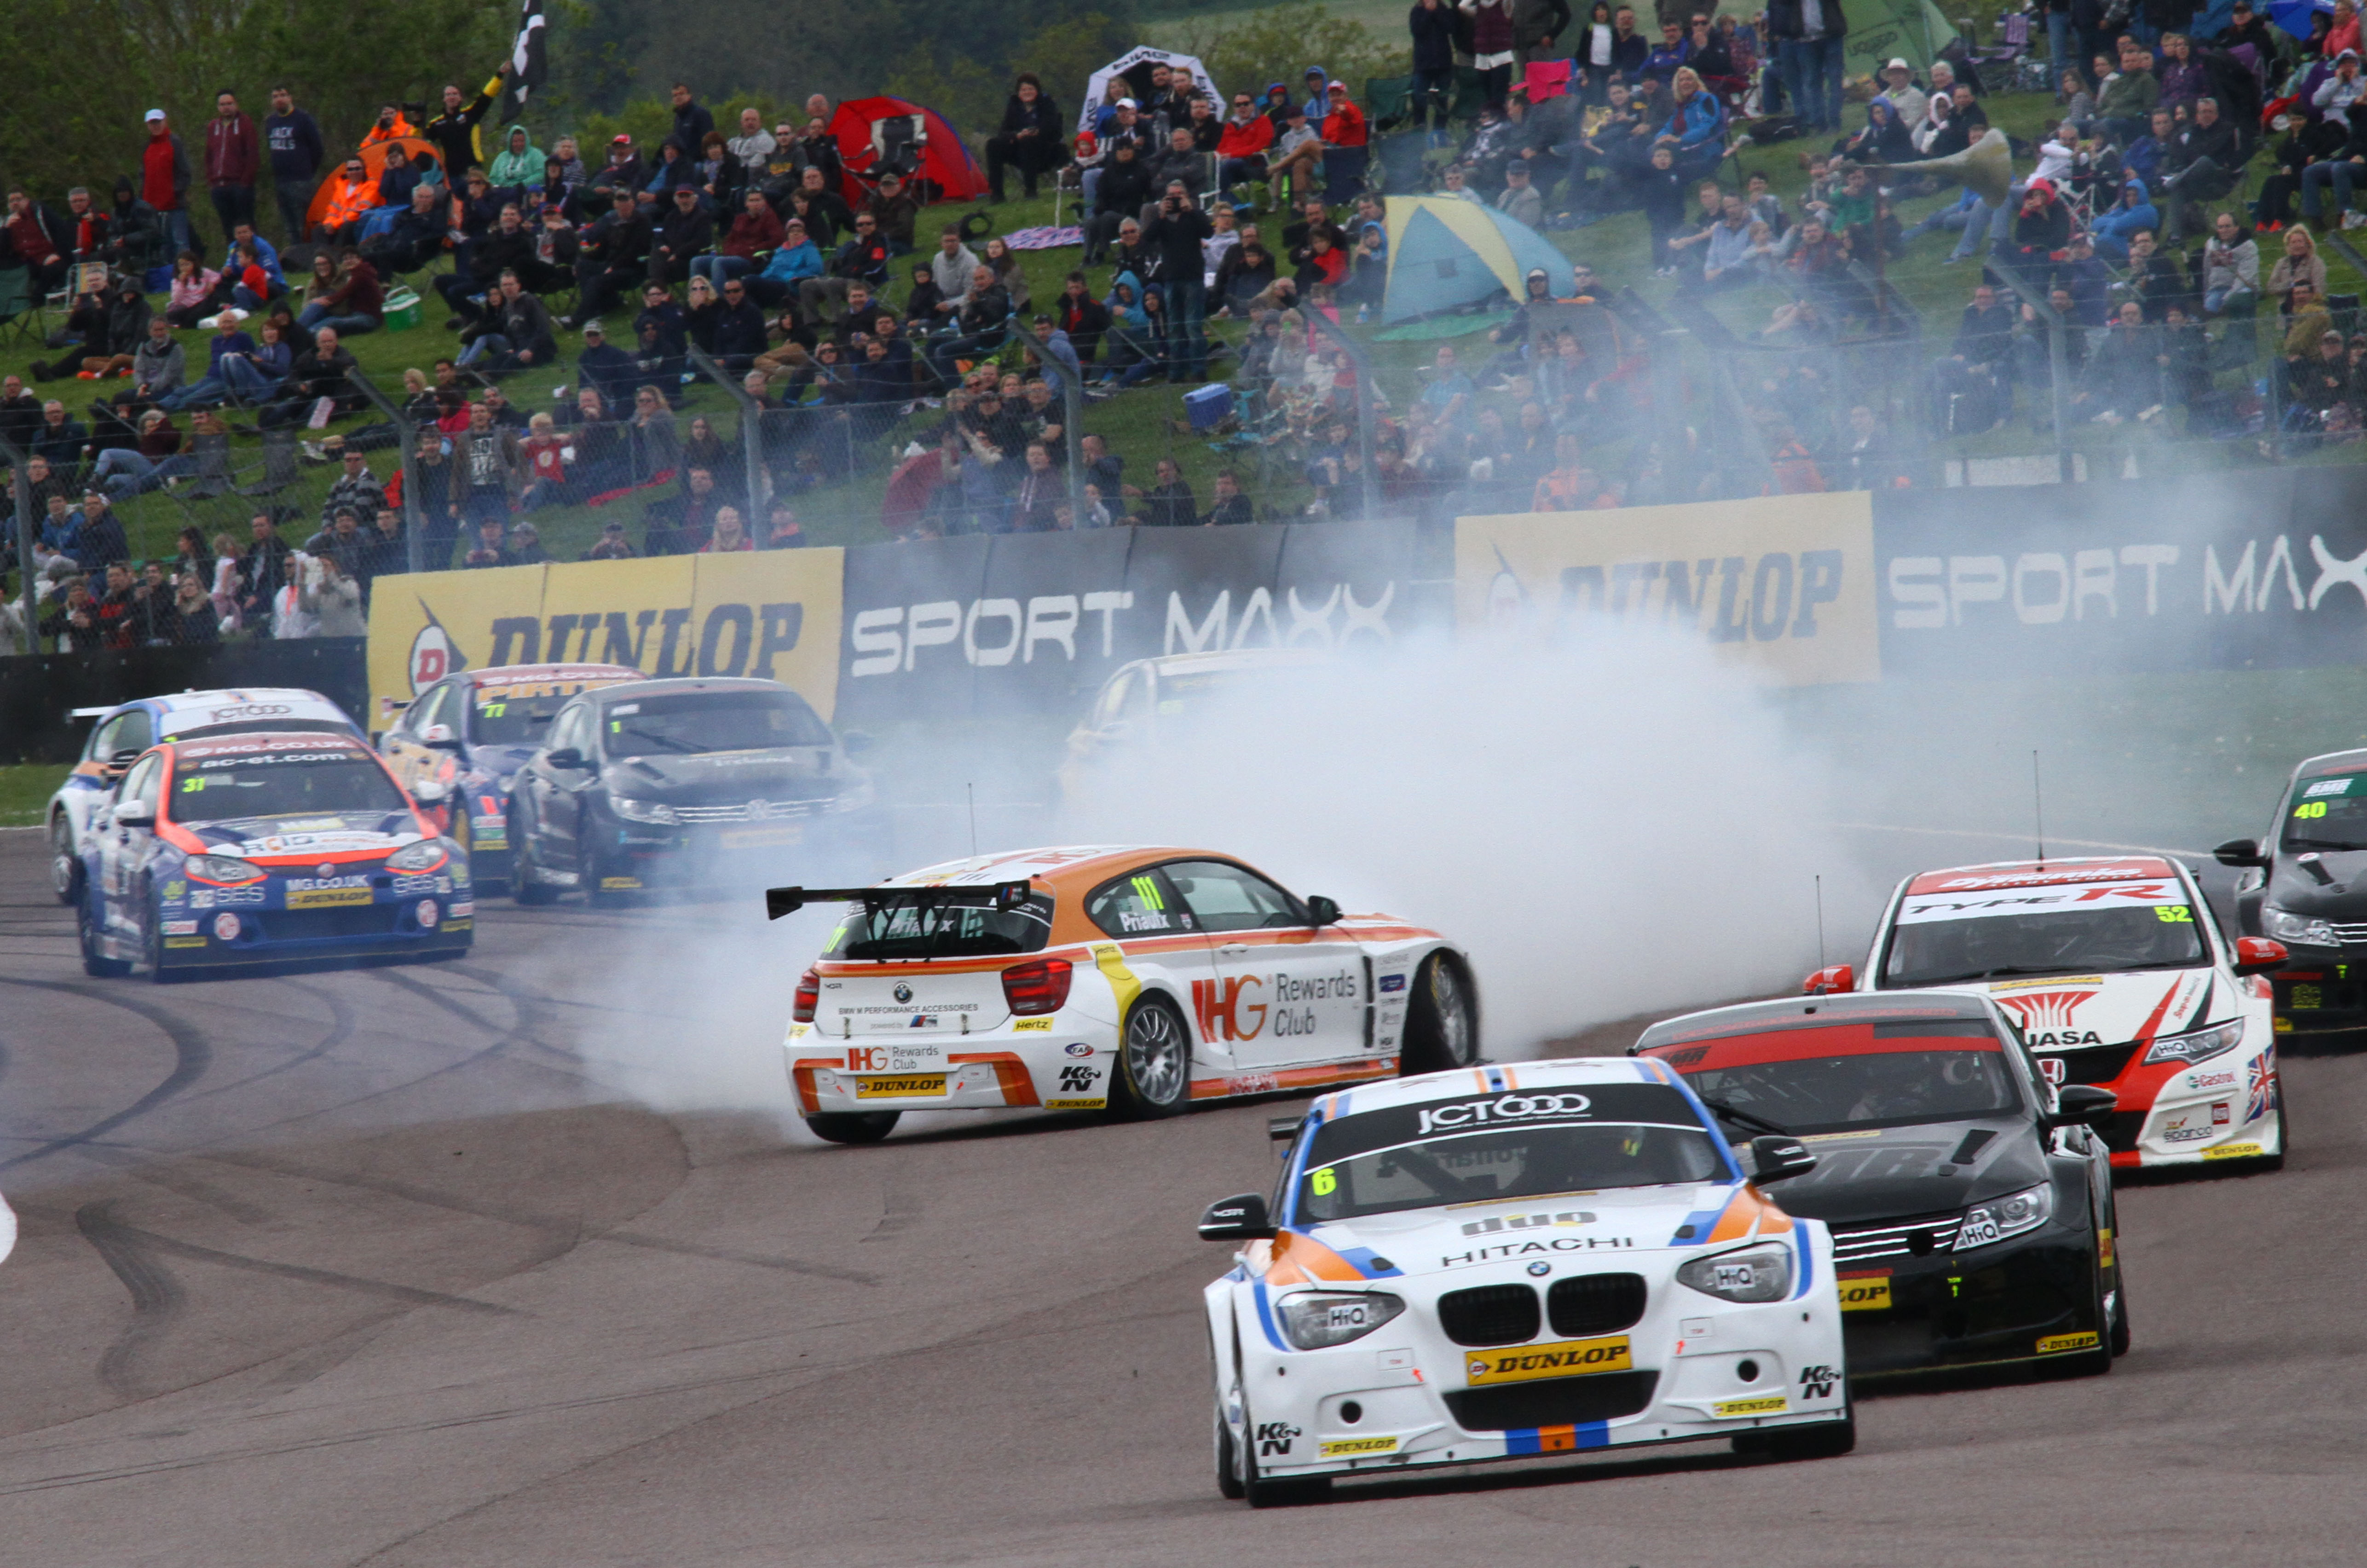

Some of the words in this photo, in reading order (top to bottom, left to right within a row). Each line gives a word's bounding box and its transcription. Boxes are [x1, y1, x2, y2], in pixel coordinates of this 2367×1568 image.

[1889, 544, 2180, 629] SPORT
[1559, 549, 1845, 645] DUNLOP
[851, 590, 1134, 677] SPORT
[1164, 581, 1395, 656] MAXX
[487, 602, 803, 682] DUNLOP
[484, 703, 506, 718] 77
[200, 753, 347, 769] ac-et.com
[182, 777, 206, 793] 31
[2293, 801, 2328, 819] 40
[286, 875, 369, 892] MG.CO.UK
[393, 874, 434, 893] SES
[215, 886, 266, 903] SES
[1131, 876, 1165, 911] 111
[1909, 895, 2068, 915] TYPE
[2073, 884, 2178, 902] R
[2153, 905, 2194, 923] 52
[864, 1006, 920, 1014] PERFORMANCE
[921, 1003, 978, 1012] ACCESSORIES
[1191, 974, 1268, 1043] IHG
[1276, 969, 1357, 1002] Rewards
[1016, 1020, 1048, 1030] Hertz
[1275, 1007, 1316, 1037] Club
[2029, 1031, 2103, 1047] ASA
[848, 1047, 888, 1070] IHG
[892, 1046, 939, 1057] Rewards
[893, 1059, 917, 1070] Club
[871, 1079, 944, 1092] DUNLOP
[2199, 1070, 2237, 1087] Castrol
[1418, 1093, 1592, 1135] JCT600
[2164, 1126, 2213, 1143] sparco
[2214, 1144, 2260, 1156] DUNLOP
[1311, 1168, 1337, 1196] 6
[1964, 1226, 1999, 1245] HiQ
[1442, 1237, 1634, 1267] HITACHI
[1719, 1266, 1752, 1287] HiQ
[1331, 1307, 1364, 1326] HiQ
[2050, 1336, 2097, 1349] DUNLOP
[1495, 1344, 1628, 1373] DUNLOP
[1726, 1398, 1786, 1414] DUNLOP
[1333, 1438, 1396, 1453] DUNLOP
